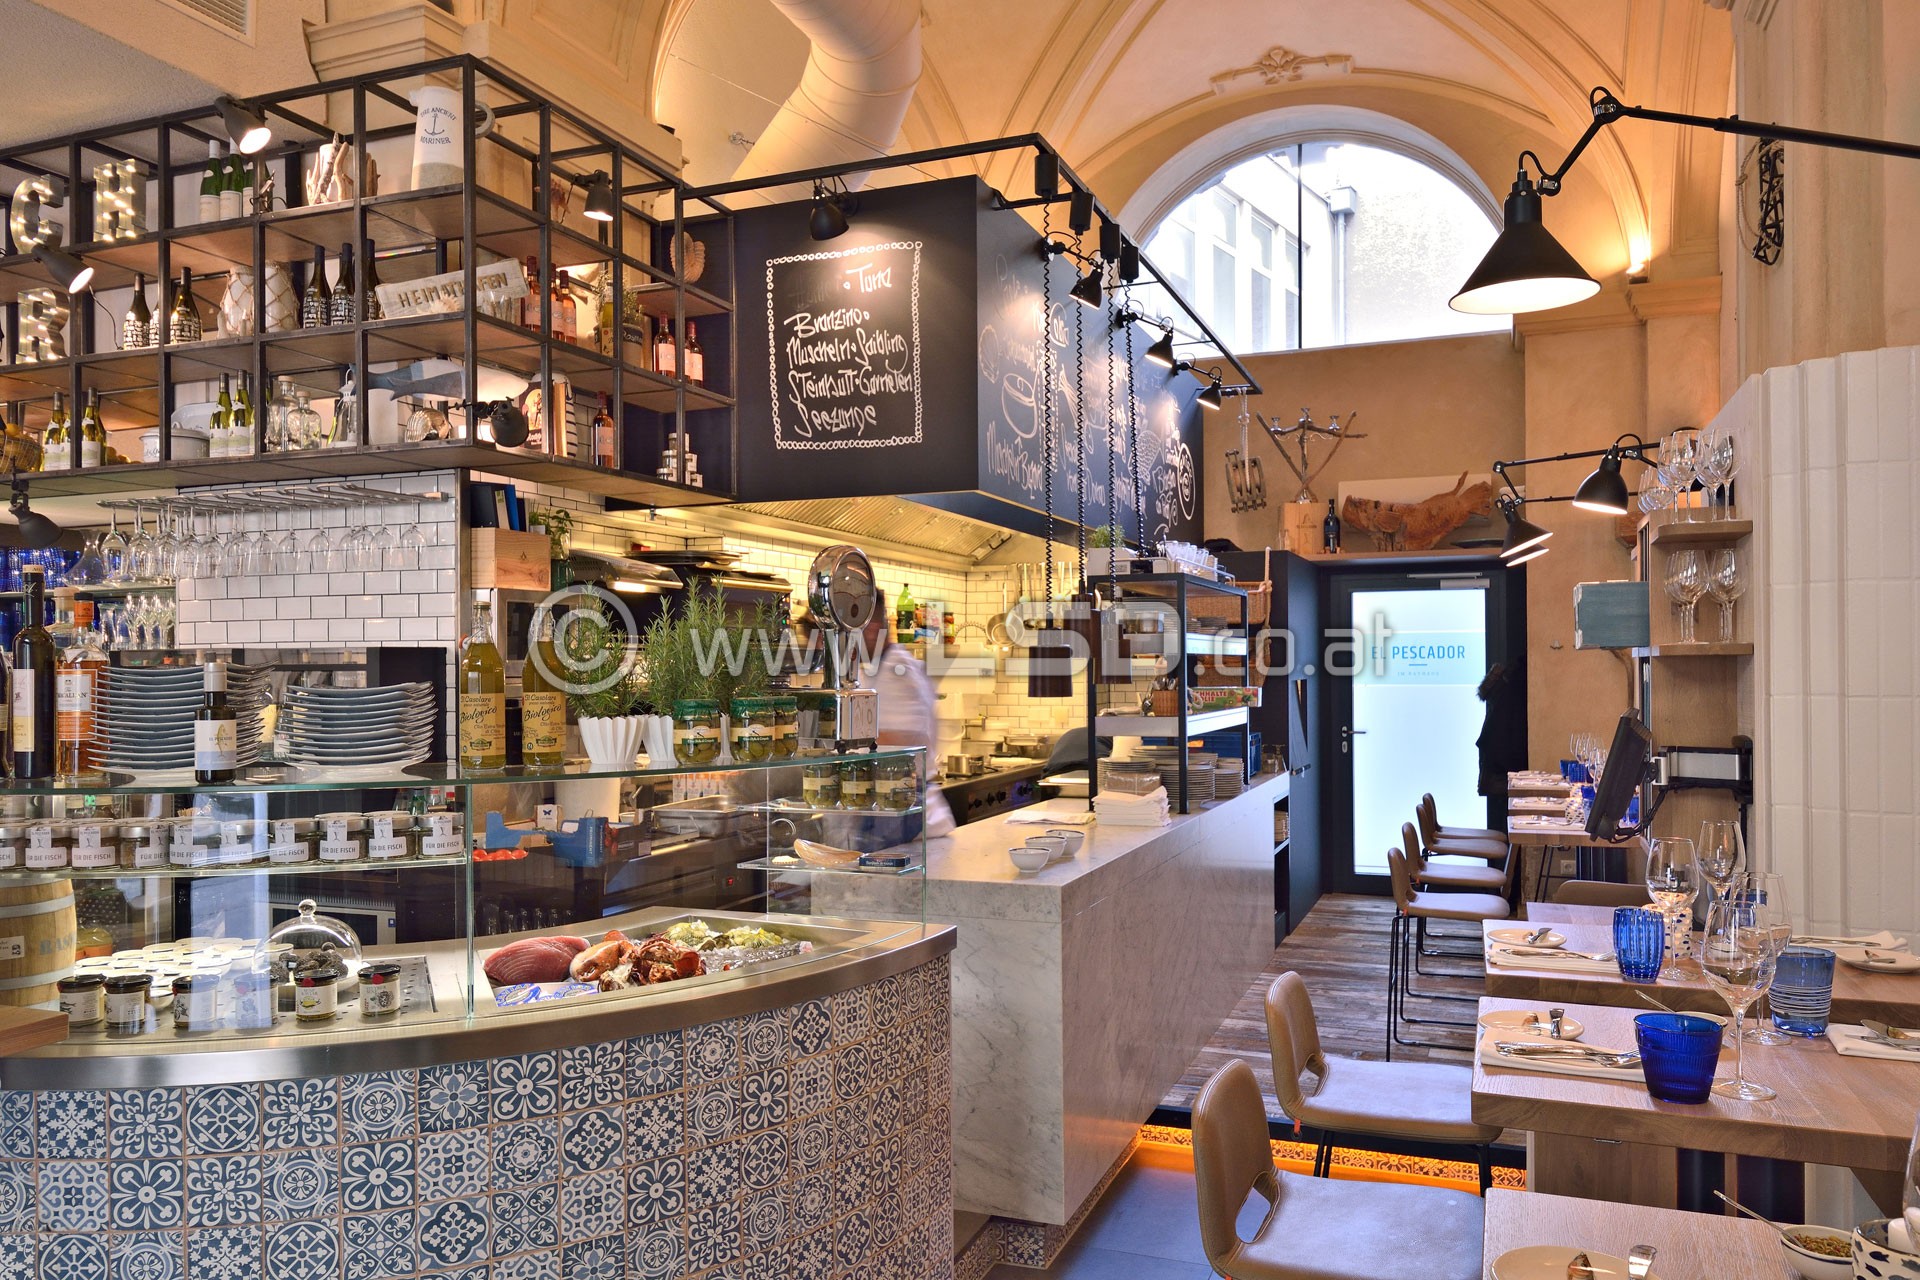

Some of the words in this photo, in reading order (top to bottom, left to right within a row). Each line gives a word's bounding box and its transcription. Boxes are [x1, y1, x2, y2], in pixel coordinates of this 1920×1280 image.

[420, 136, 452, 144] MARINER
[845, 262, 892, 293] Tuna
[1372, 646, 1386, 660] EL
[1392, 646, 1466, 660] PESCADOR
[460, 706, 497, 723] Biologico
[524, 703, 562, 721] Biologico
